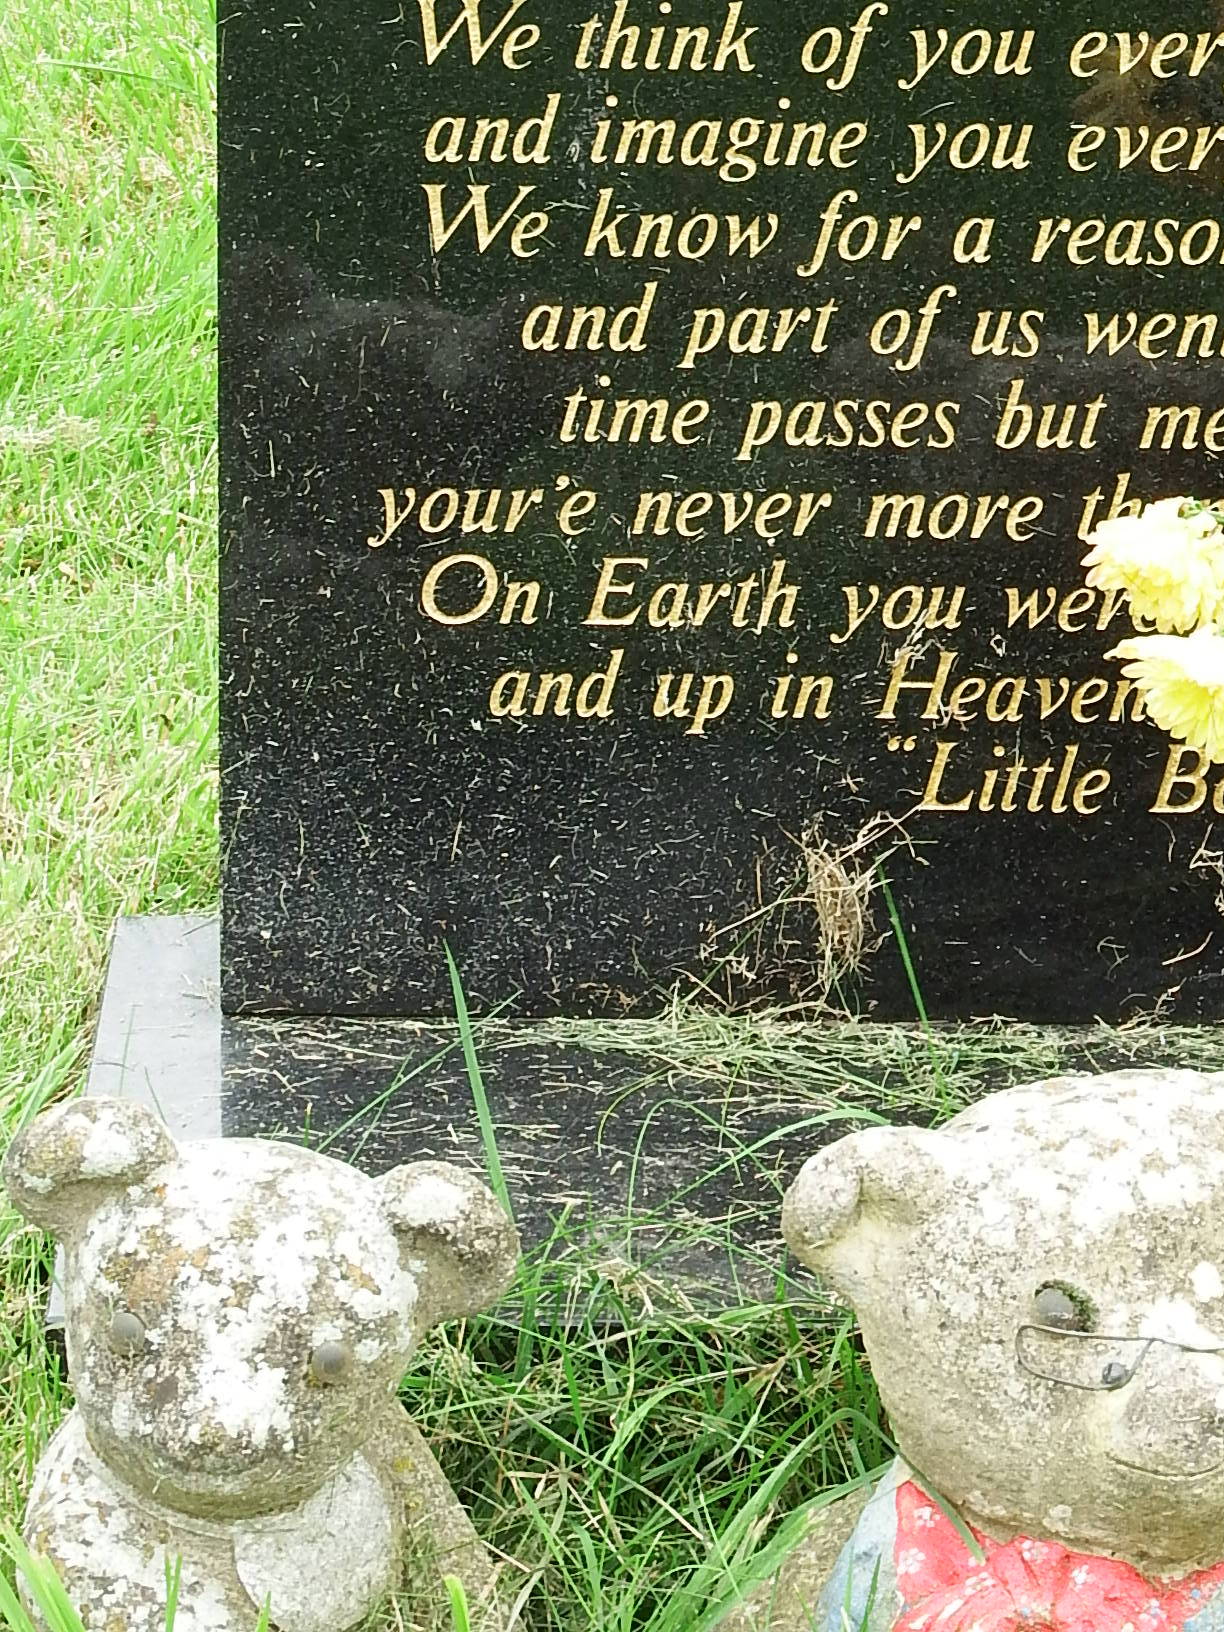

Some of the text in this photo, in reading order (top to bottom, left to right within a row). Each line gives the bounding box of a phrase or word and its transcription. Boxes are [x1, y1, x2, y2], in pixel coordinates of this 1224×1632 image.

[801, 1, 888, 90] of
[898, 28, 1035, 88] you
[423, 94, 560, 165] and
[590, 96, 868, 182] imagine
[895, 122, 1034, 184] you
[420, 183, 549, 258] We
[584, 188, 779, 261] know
[796, 189, 922, 277] for
[952, 217, 996, 264] a
[521, 281, 659, 352] and
[680, 297, 839, 369] part
[869, 284, 956, 372] of
[972, 309, 1045, 360] us
[558, 375, 710, 445] time
[737, 396, 961, 460] passes
[994, 378, 1108, 450] but
[631, 490, 833, 538] never
[861, 493, 1044, 542] more
[417, 553, 541, 625] On
[582, 557, 799, 632] Earth
[831, 585, 979, 645] you
[489, 654, 625, 722] and
[652, 668, 735, 737] up
[770, 651, 834, 720] in
[876, 650, 1152, 725] Heaven
